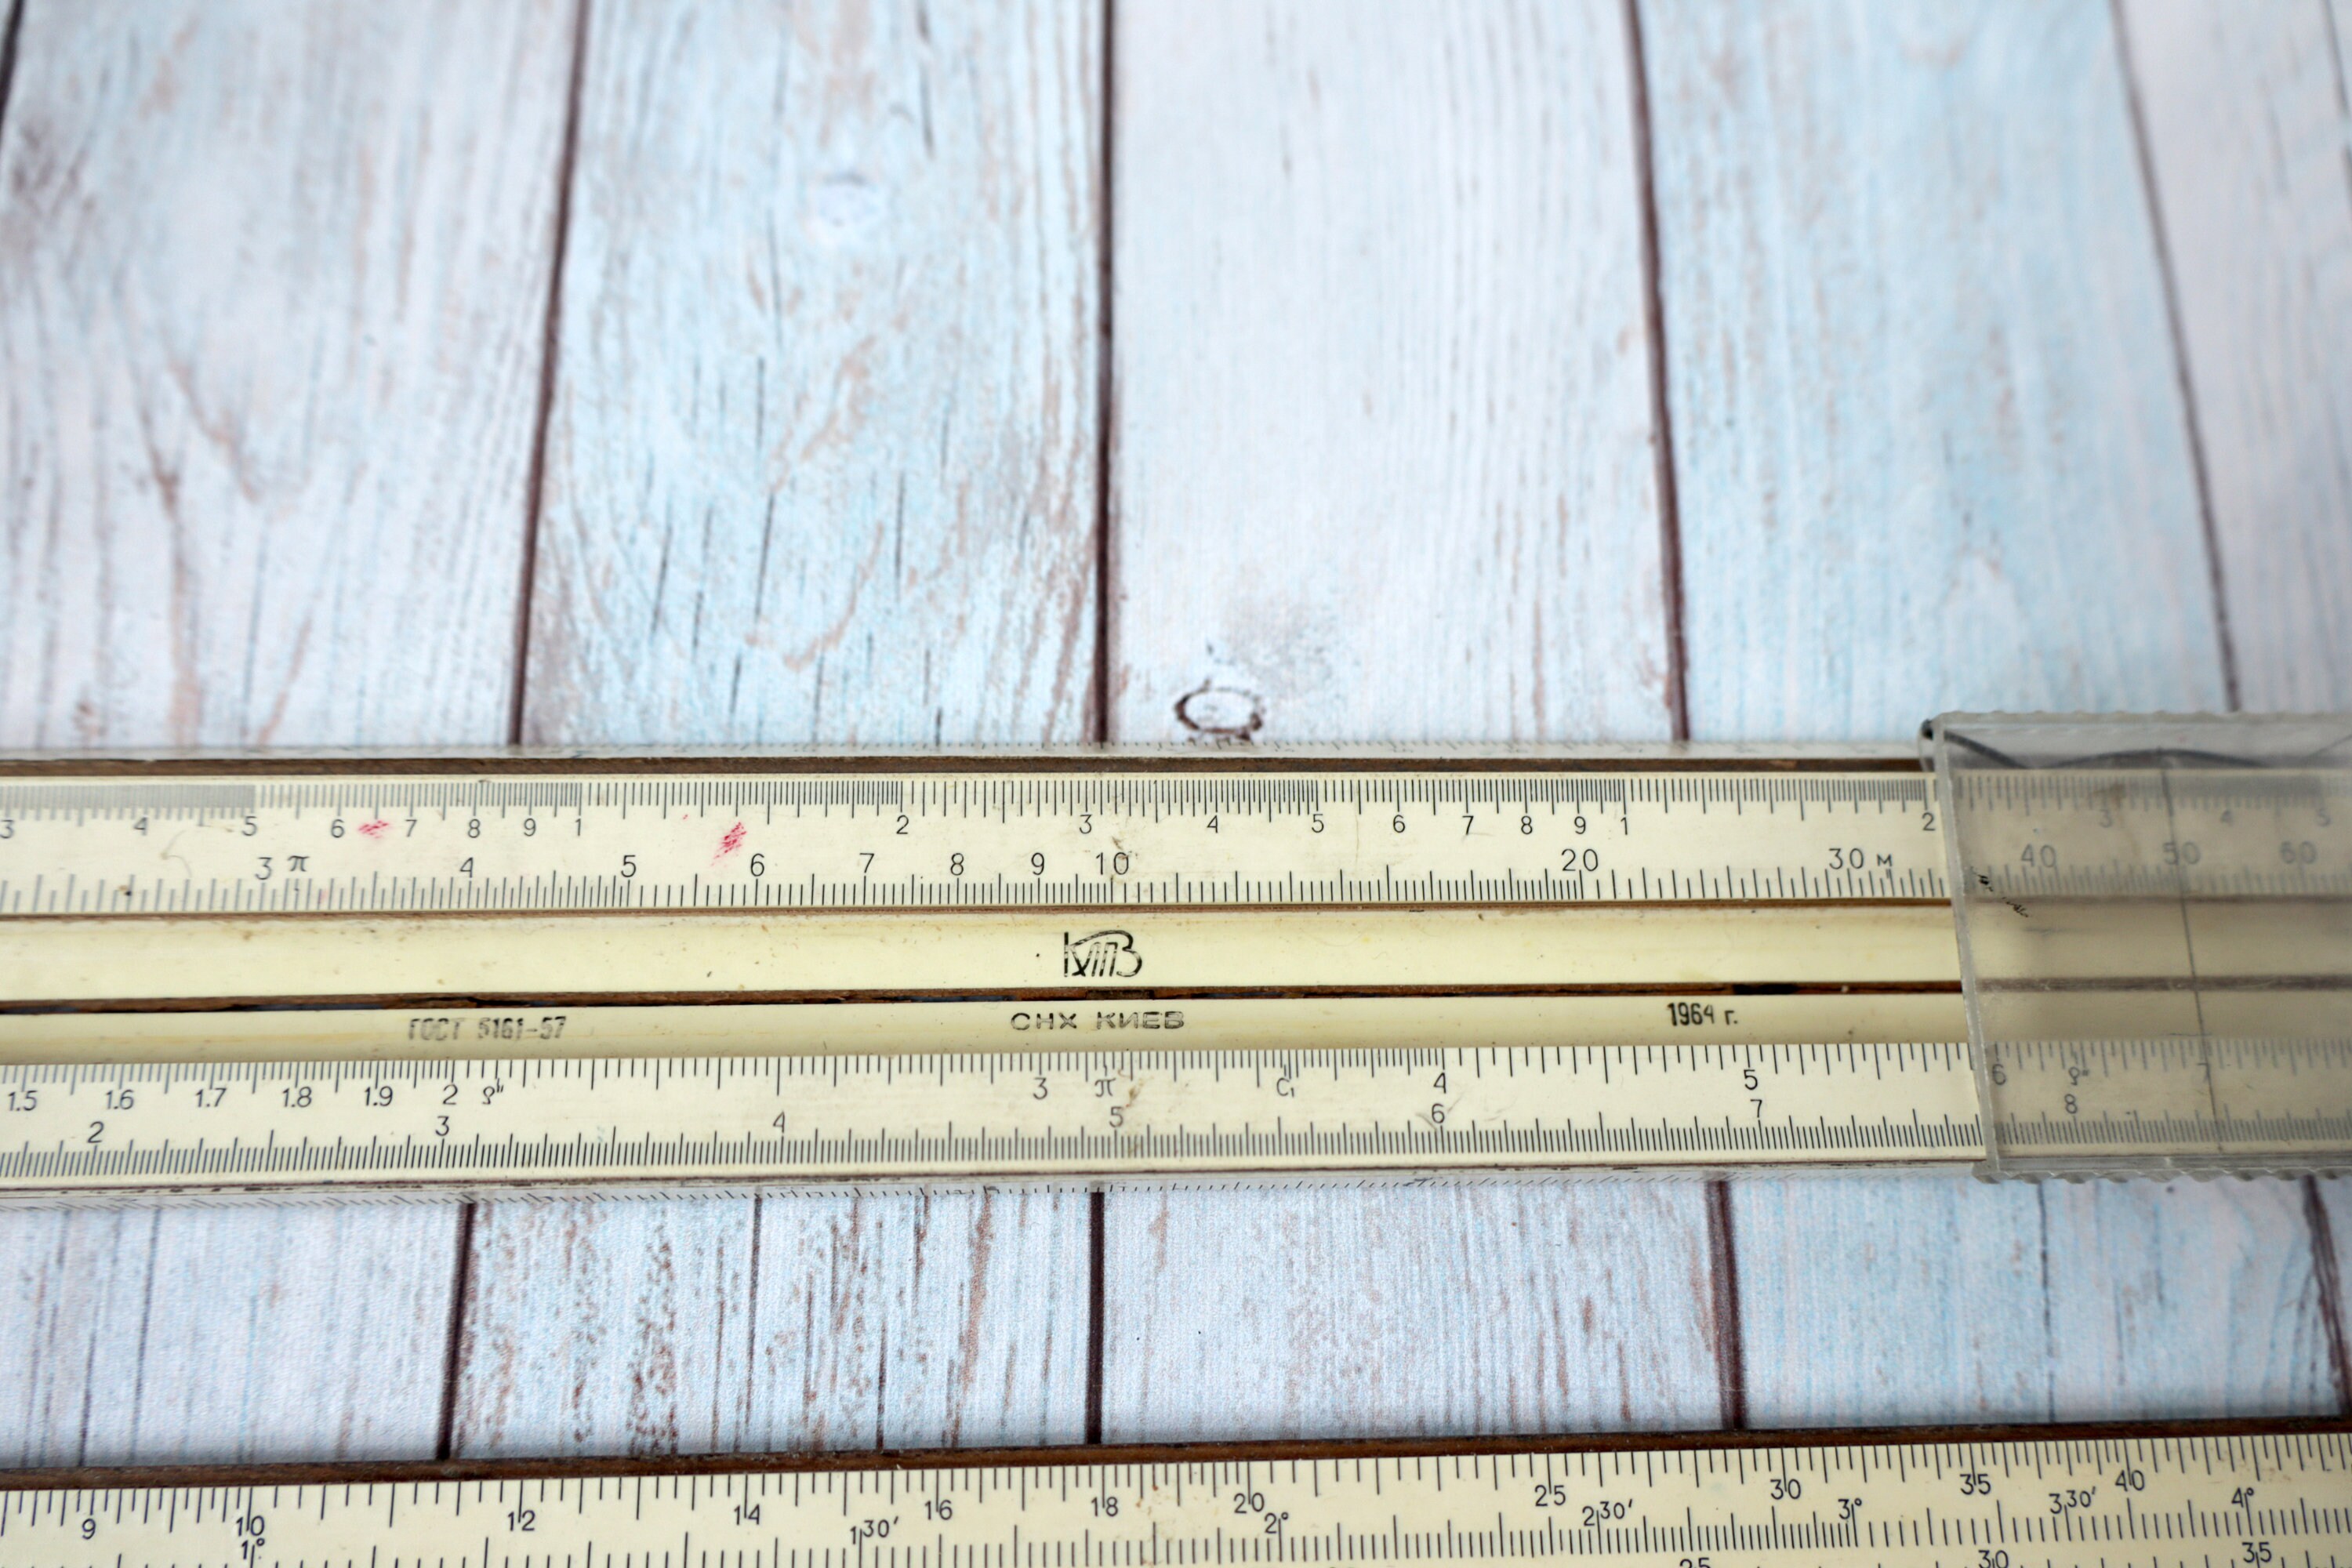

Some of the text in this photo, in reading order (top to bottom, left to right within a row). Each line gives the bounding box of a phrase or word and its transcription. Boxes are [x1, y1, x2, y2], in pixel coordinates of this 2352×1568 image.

[0, 819, 15, 839] 3
[133, 816, 148, 836] 4
[241, 816, 258, 837] 5
[330, 819, 346, 838] 6
[405, 819, 417, 837] 7
[466, 819, 481, 838] 8
[523, 818, 537, 837] 9
[574, 818, 582, 837] 1
[895, 815, 909, 835] 2
[1079, 814, 1093, 834] 3
[1206, 815, 1220, 833] 4
[1310, 814, 1325, 833] 5
[1392, 813, 1406, 833] 6
[1461, 815, 1475, 835] 7
[1519, 815, 1534, 835] 8
[1573, 815, 1587, 834] 9
[1620, 815, 1628, 835] 1
[1922, 811, 1936, 832] 2
[255, 856, 273, 880] 3
[289, 855, 310, 873] π
[459, 856, 475, 879] 4
[620, 855, 637, 879] 5
[750, 852, 765, 877] 6
[858, 852, 875, 874] 7
[949, 852, 965, 876] 8
[1030, 851, 1045, 875] 9
[1095, 851, 1130, 876] 10
[1561, 848, 1599, 872] 20
[1828, 848, 1864, 870] 30
[2021, 844, 2057, 869] 40
[2161, 840, 2201, 865] 50
[2278, 840, 2318, 864] 60
[1010, 1011, 1185, 1032] СНХ КИЕВ
[1668, 1002, 1738, 1026] 1964 г.
[408, 1018, 464, 1041] ГОСТ
[8, 1089, 38, 1112] 1.5
[106, 1090, 135, 1111] 1.6
[196, 1087, 227, 1108] 1.7
[282, 1086, 313, 1108] 1.8
[364, 1086, 394, 1106] 1.9
[442, 1084, 458, 1105] 2
[1033, 1077, 1048, 1100] 3
[1433, 1073, 1447, 1094] 4
[1743, 1069, 1759, 1091] 5
[1992, 1063, 2006, 1086] 6
[87, 1094, 2078, 1145] 2 3 4 5 6 7 8
[81, 1469, 2145, 1540] 9 10 12 14 16 18 20 25 30 35 40
[1978, 1549, 2009, 1568] 30
[2242, 1541, 2271, 1563] 35
